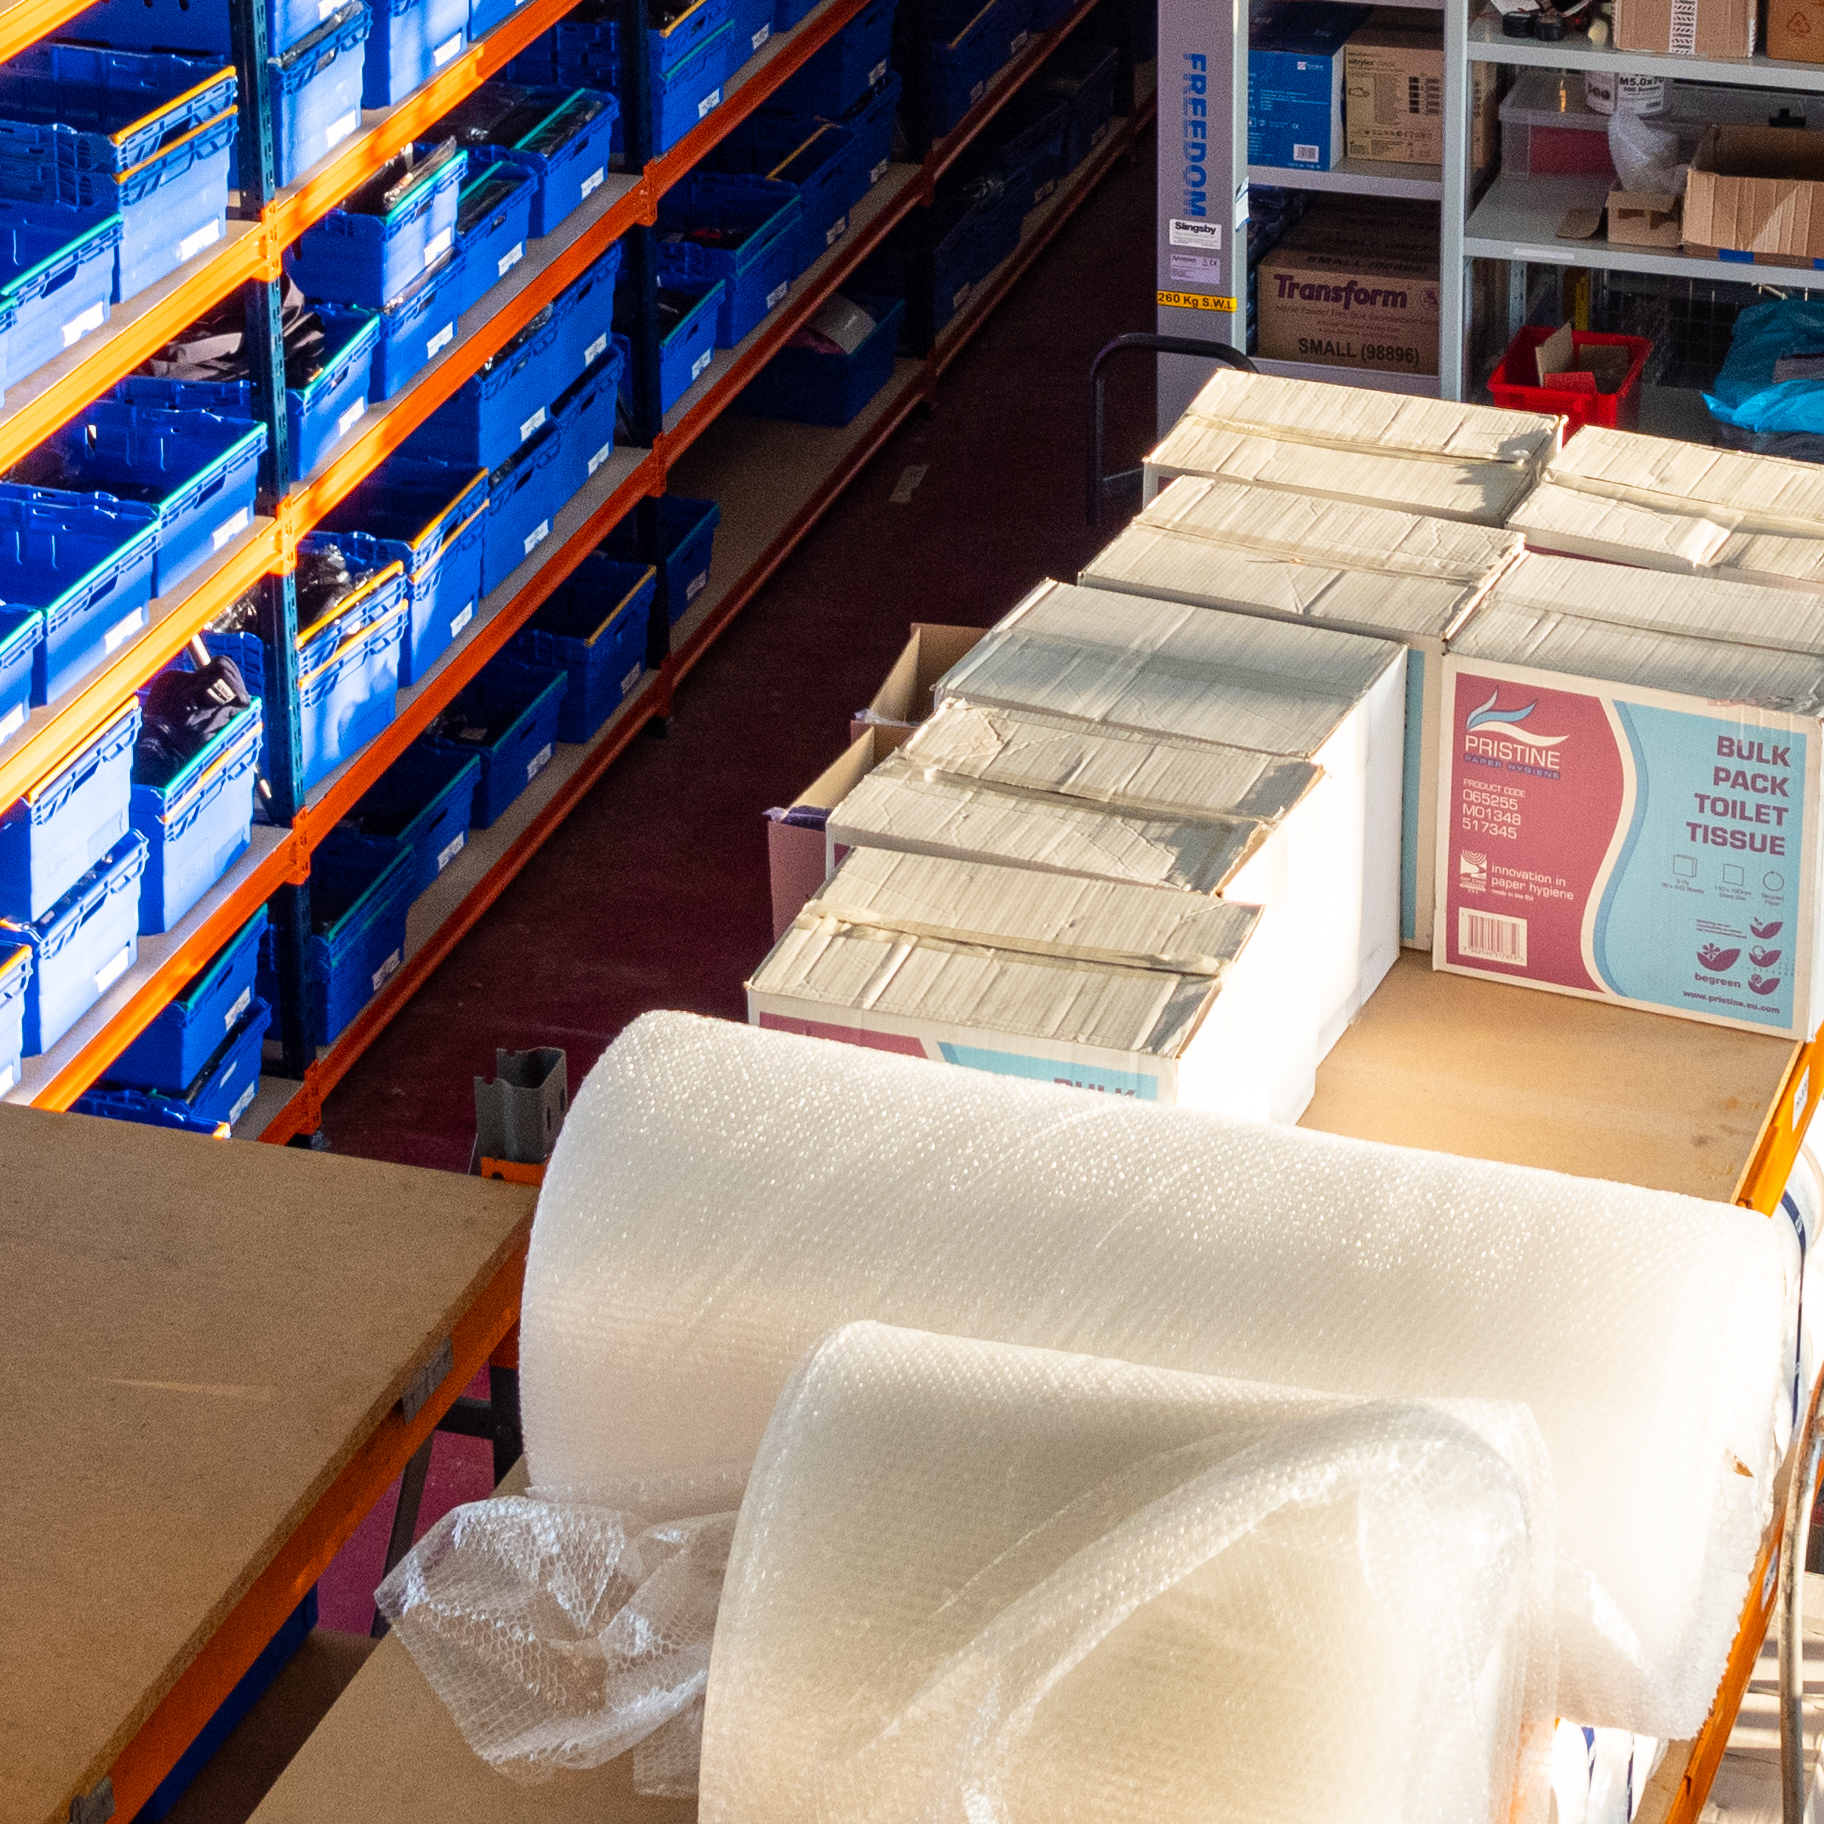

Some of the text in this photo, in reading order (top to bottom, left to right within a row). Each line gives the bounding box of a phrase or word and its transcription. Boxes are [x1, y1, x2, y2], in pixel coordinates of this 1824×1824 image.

[1183, 52, 1207, 218] FREEDOM
[1174, 221, 1217, 236] Slingsby
[1158, 292, 1180, 304] 260
[1183, 295, 1199, 310] Kg
[1274, 273, 1408, 311] Transform
[1298, 337, 1420, 367] SMALL (98896)
[1464, 734, 1561, 770] PRISTINE
[1717, 734, 1791, 768] BULK
[1464, 754, 1560, 780] PAPER HYGIENE
[1463, 778, 1526, 799] PRODUCT CODE
[1713, 765, 1791, 798] PACK
[1462, 788, 1518, 811] 065255
[1694, 792, 1789, 827] TOILET
[1462, 802, 1522, 826] M01348
[1461, 817, 1518, 840] 517345
[1686, 821, 1786, 856] TISSUE
[1492, 864, 1567, 887] innovation in
[1491, 877, 1527, 893] paper
[1529, 882, 1575, 901] hygiene
[1694, 972, 1742, 989] begreen
[1682, 990, 1781, 1015] www.pristine.eu.com
